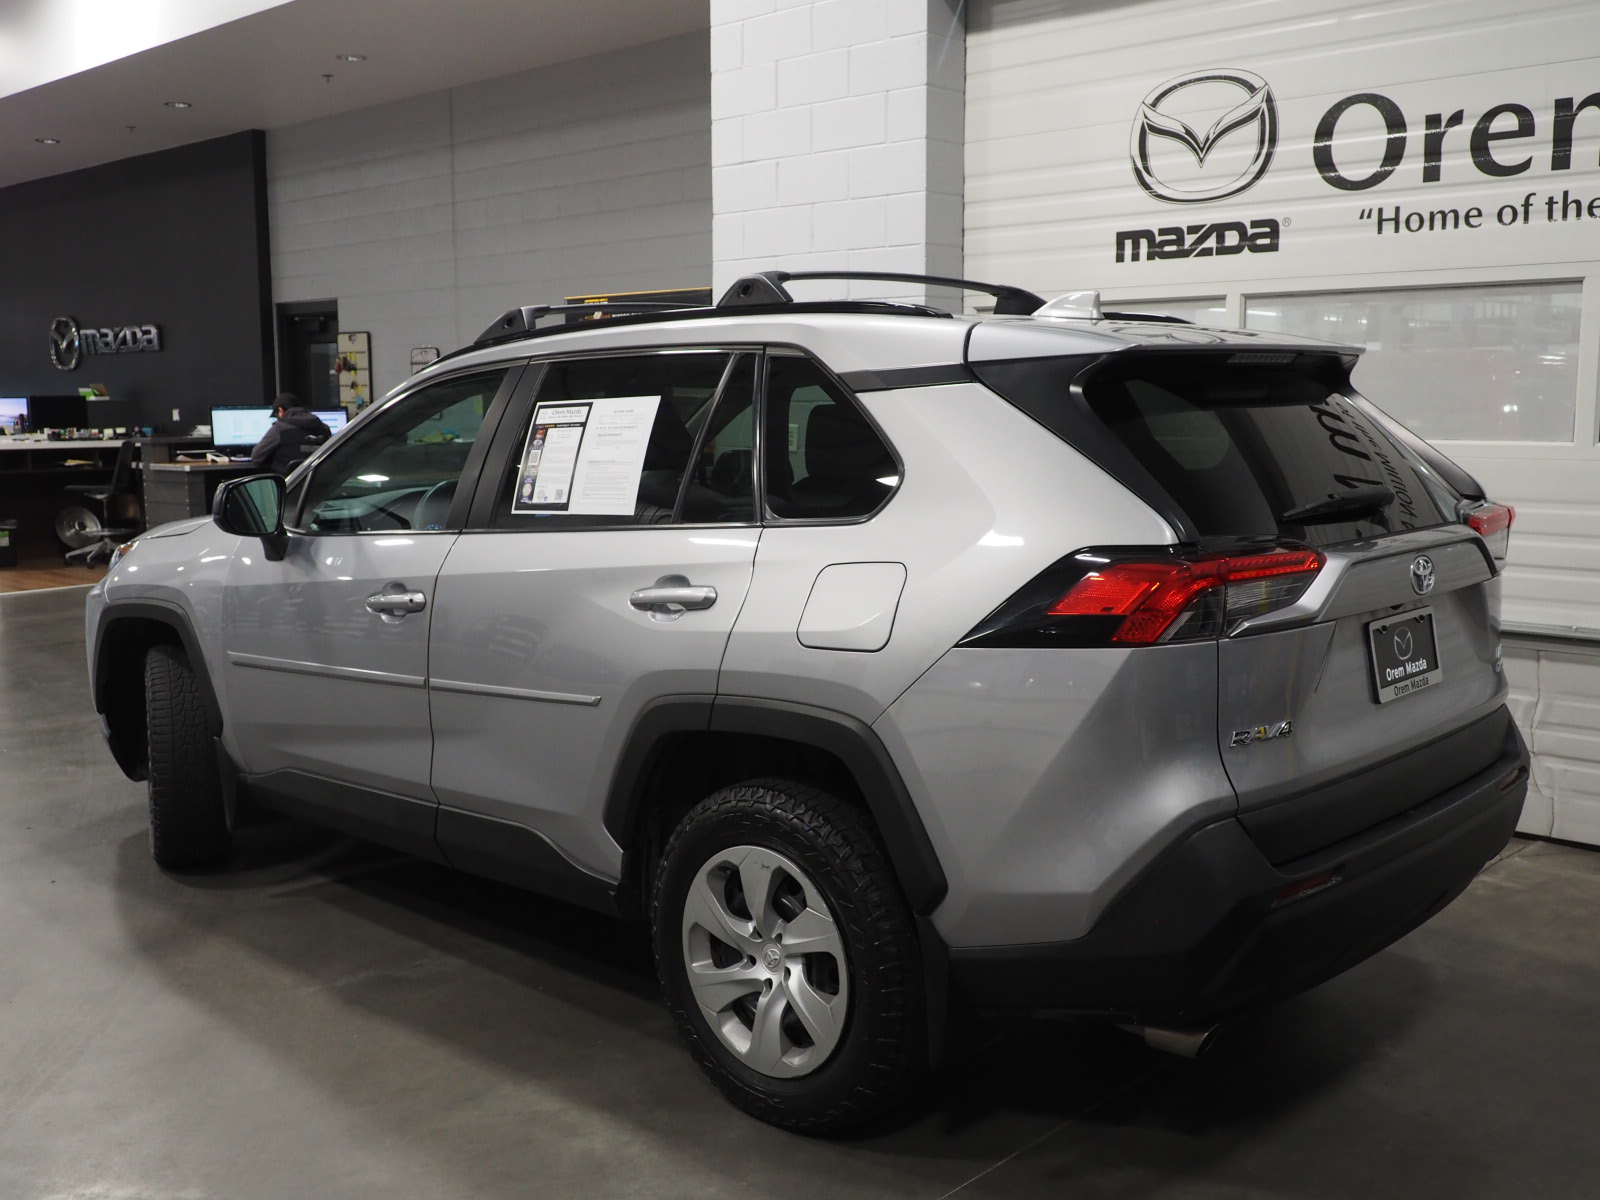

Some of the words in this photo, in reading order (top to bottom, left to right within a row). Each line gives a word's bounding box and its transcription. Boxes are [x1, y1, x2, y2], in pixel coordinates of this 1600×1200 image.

[1497, 193, 1536, 225] of
[1545, 190, 1600, 222] the
[1386, 668, 1405, 681] Orem
[1405, 658, 1428, 674] Mazda
[1394, 685, 1410, 696] Orem
[1410, 676, 1429, 690] Mazda
[1229, 720, 1293, 747] RAV4
